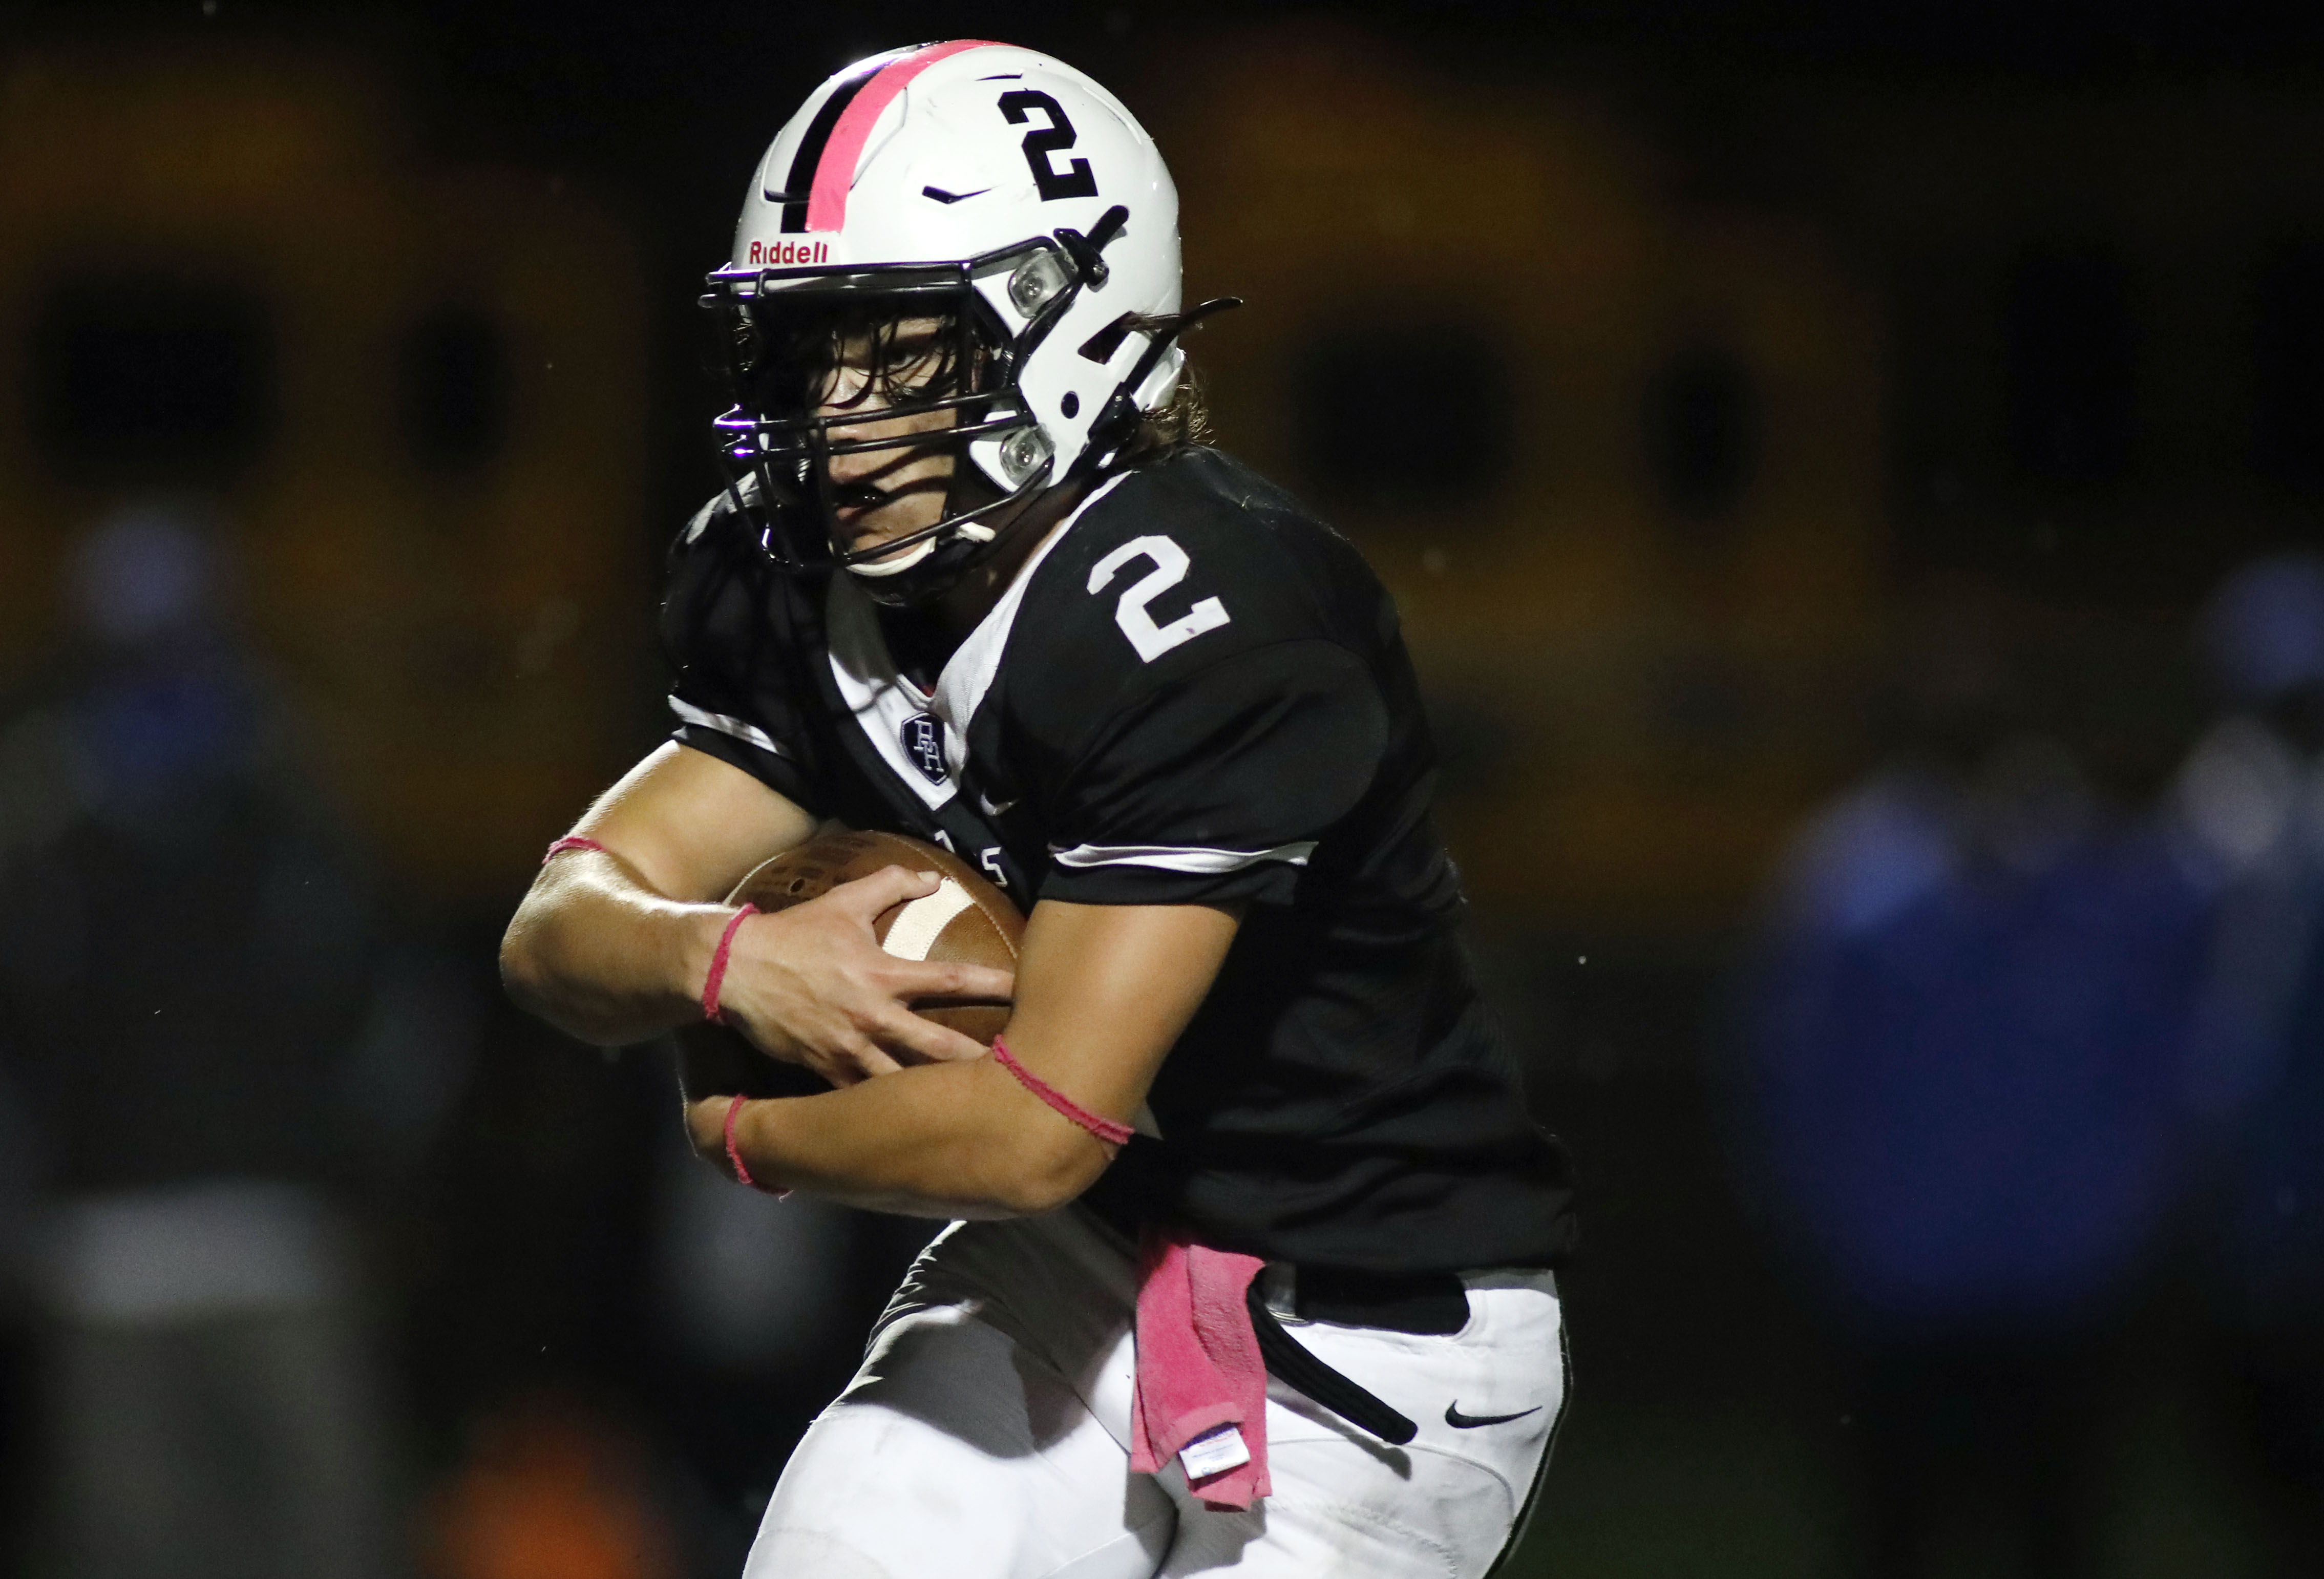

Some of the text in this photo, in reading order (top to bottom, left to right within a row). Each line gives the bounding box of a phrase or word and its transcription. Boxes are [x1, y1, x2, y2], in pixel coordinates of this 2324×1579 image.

[997, 90, 1099, 202] 2
[749, 241, 828, 264] Riddell
[1086, 535, 1231, 664] 2
